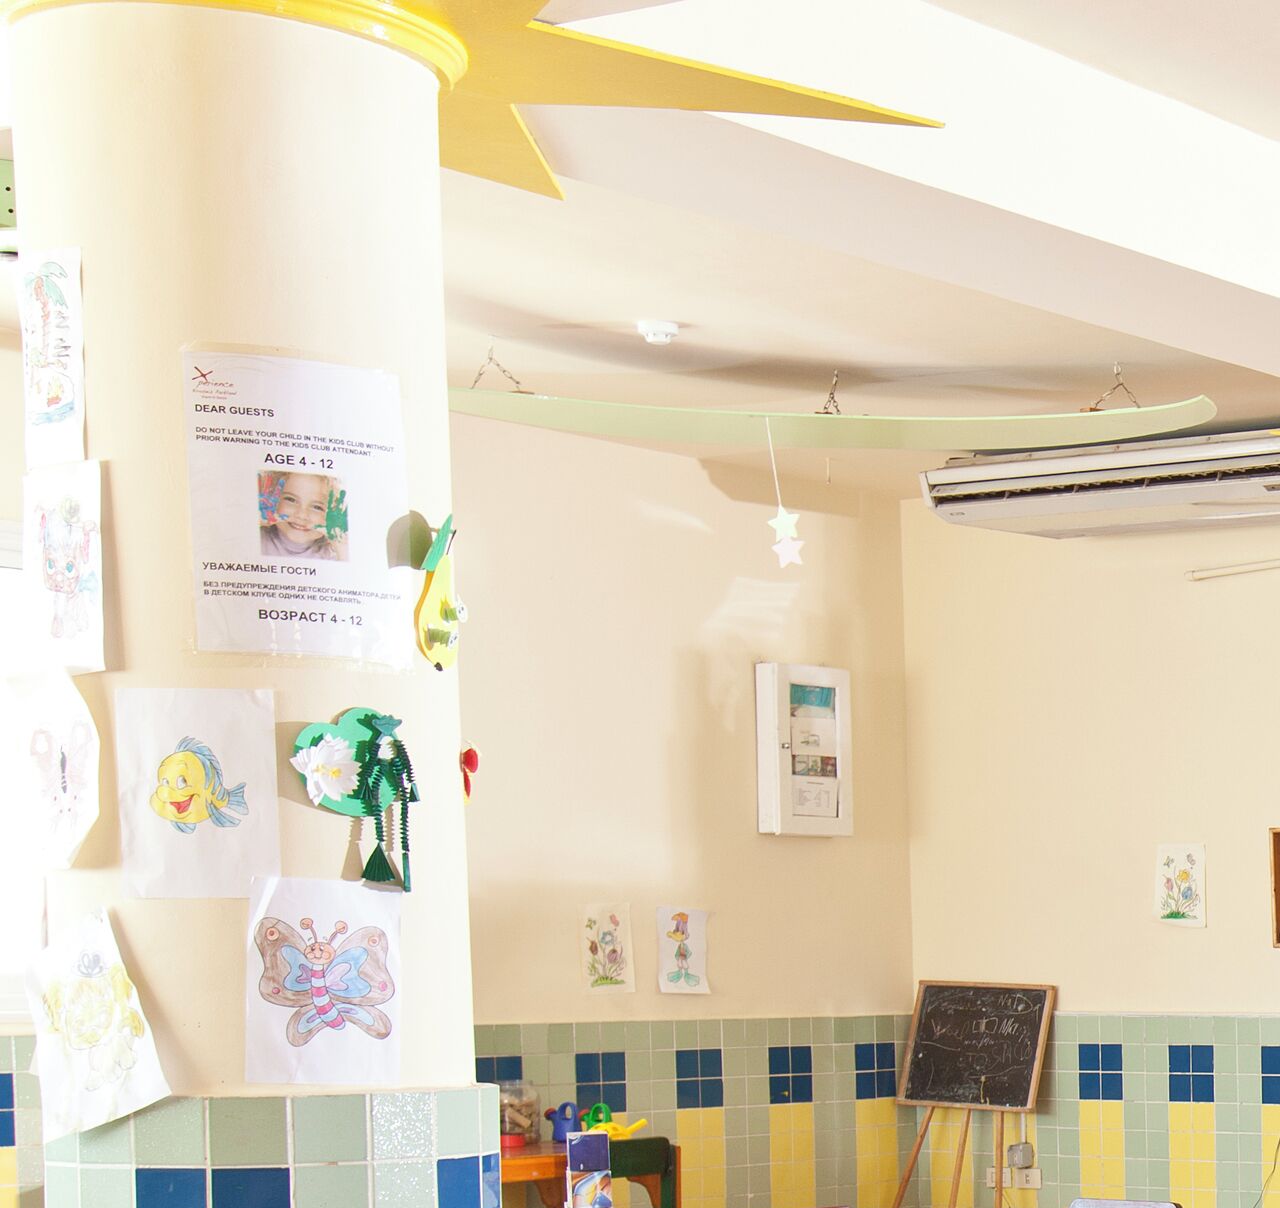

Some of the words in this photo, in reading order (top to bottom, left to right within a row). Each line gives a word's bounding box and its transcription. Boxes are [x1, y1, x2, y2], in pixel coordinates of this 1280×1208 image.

[194, 403, 226, 414] DEAR
[229, 406, 275, 418] GUESTS
[195, 434, 221, 442] PRIOR
[222, 436, 260, 445] WARNING
[275, 440, 290, 448] THE
[311, 443, 331, 452] CLUB
[332, 446, 372, 457] ATTENDANT
[228, 428, 254, 437] LEAVE
[255, 430, 278, 438] YOUR
[279, 432, 302, 440] CHILD
[346, 440, 365, 448] CLUB
[366, 443, 395, 453] WITHOUT
[264, 453, 295, 466] AGE
[298, 456, 307, 466] 4
[319, 458, 334, 470] 12
[202, 561, 278, 574] УВАЖАЕМЫЕ
[280, 565, 317, 576] ГОСТИ
[203, 580, 219, 588] БЕЗ
[220, 581, 296, 591] ПРЕДУПРЕЖДЕНИЯ
[297, 586, 337, 594] ДЕТСКОГО
[211, 589, 250, 597] ДЕТСКОМ
[251, 590, 277, 598] КЛУБЕ
[278, 592, 305, 600] ОДНИХ
[258, 608, 326, 623] ВОЗРАСТ
[330, 614, 338, 624] 4
[349, 615, 363, 626] 12
